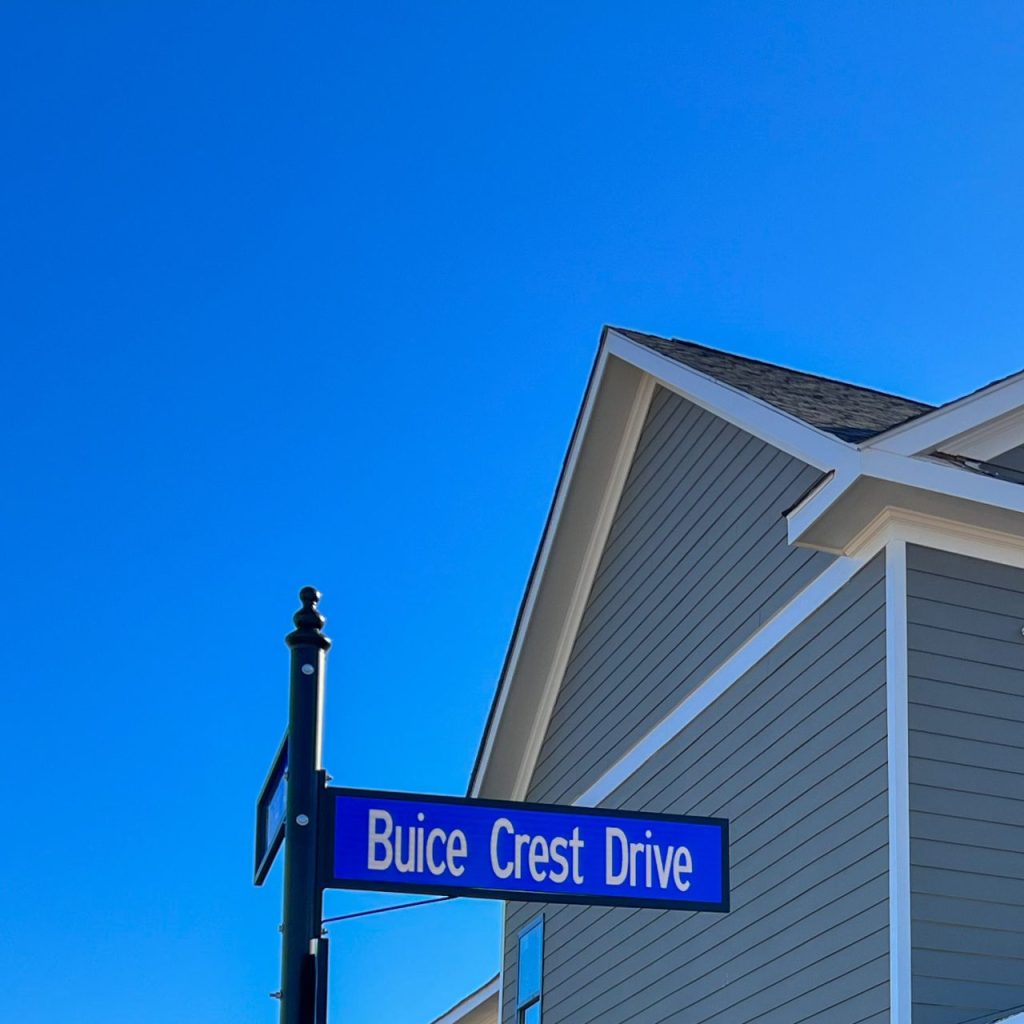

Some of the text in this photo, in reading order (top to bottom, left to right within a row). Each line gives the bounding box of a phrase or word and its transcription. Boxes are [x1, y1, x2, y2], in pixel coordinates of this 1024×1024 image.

[368, 809, 693, 892] Buice Crest Drive
